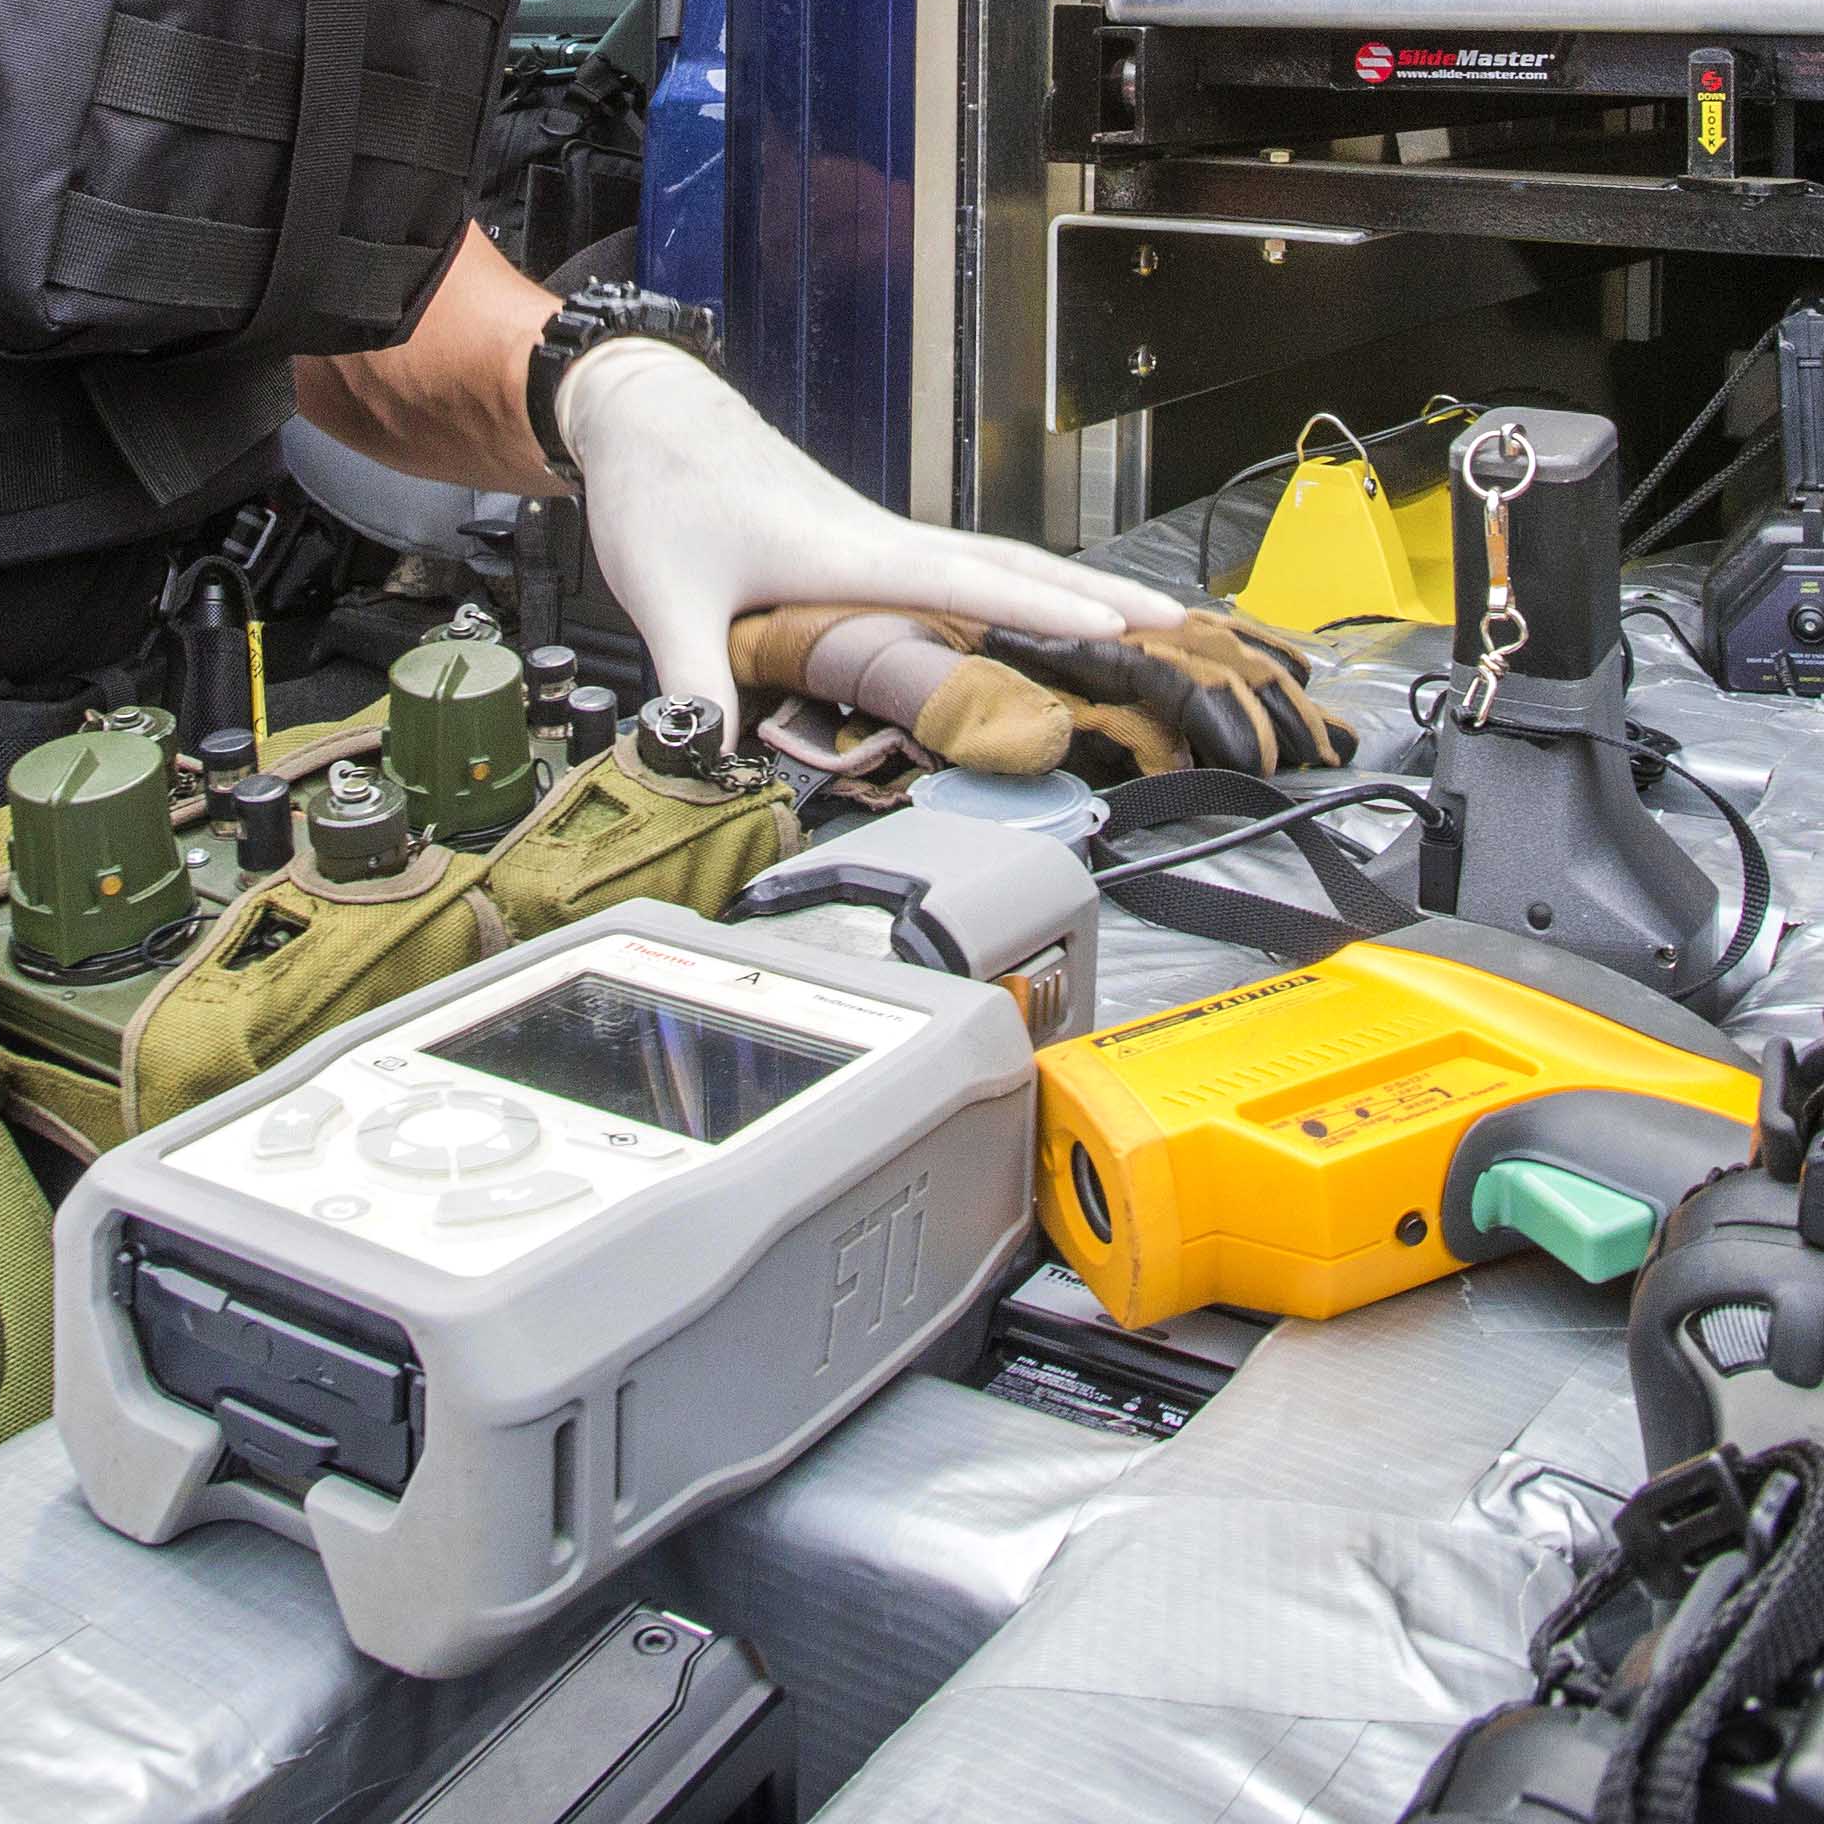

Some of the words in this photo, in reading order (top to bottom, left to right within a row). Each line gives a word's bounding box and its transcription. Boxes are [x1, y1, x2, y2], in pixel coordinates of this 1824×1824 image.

[1397, 49, 1549, 68] SlideMaster
[1396, 69, 1548, 81] www.slide-master.com
[1697, 93, 1726, 102] DOWN
[1708, 104, 1717, 147] LOCK
[624, 941, 696, 968] Thermo
[735, 971, 761, 986] A
[1201, 974, 1310, 1014] CAUTION
[814, 1170, 929, 1377] FTi
